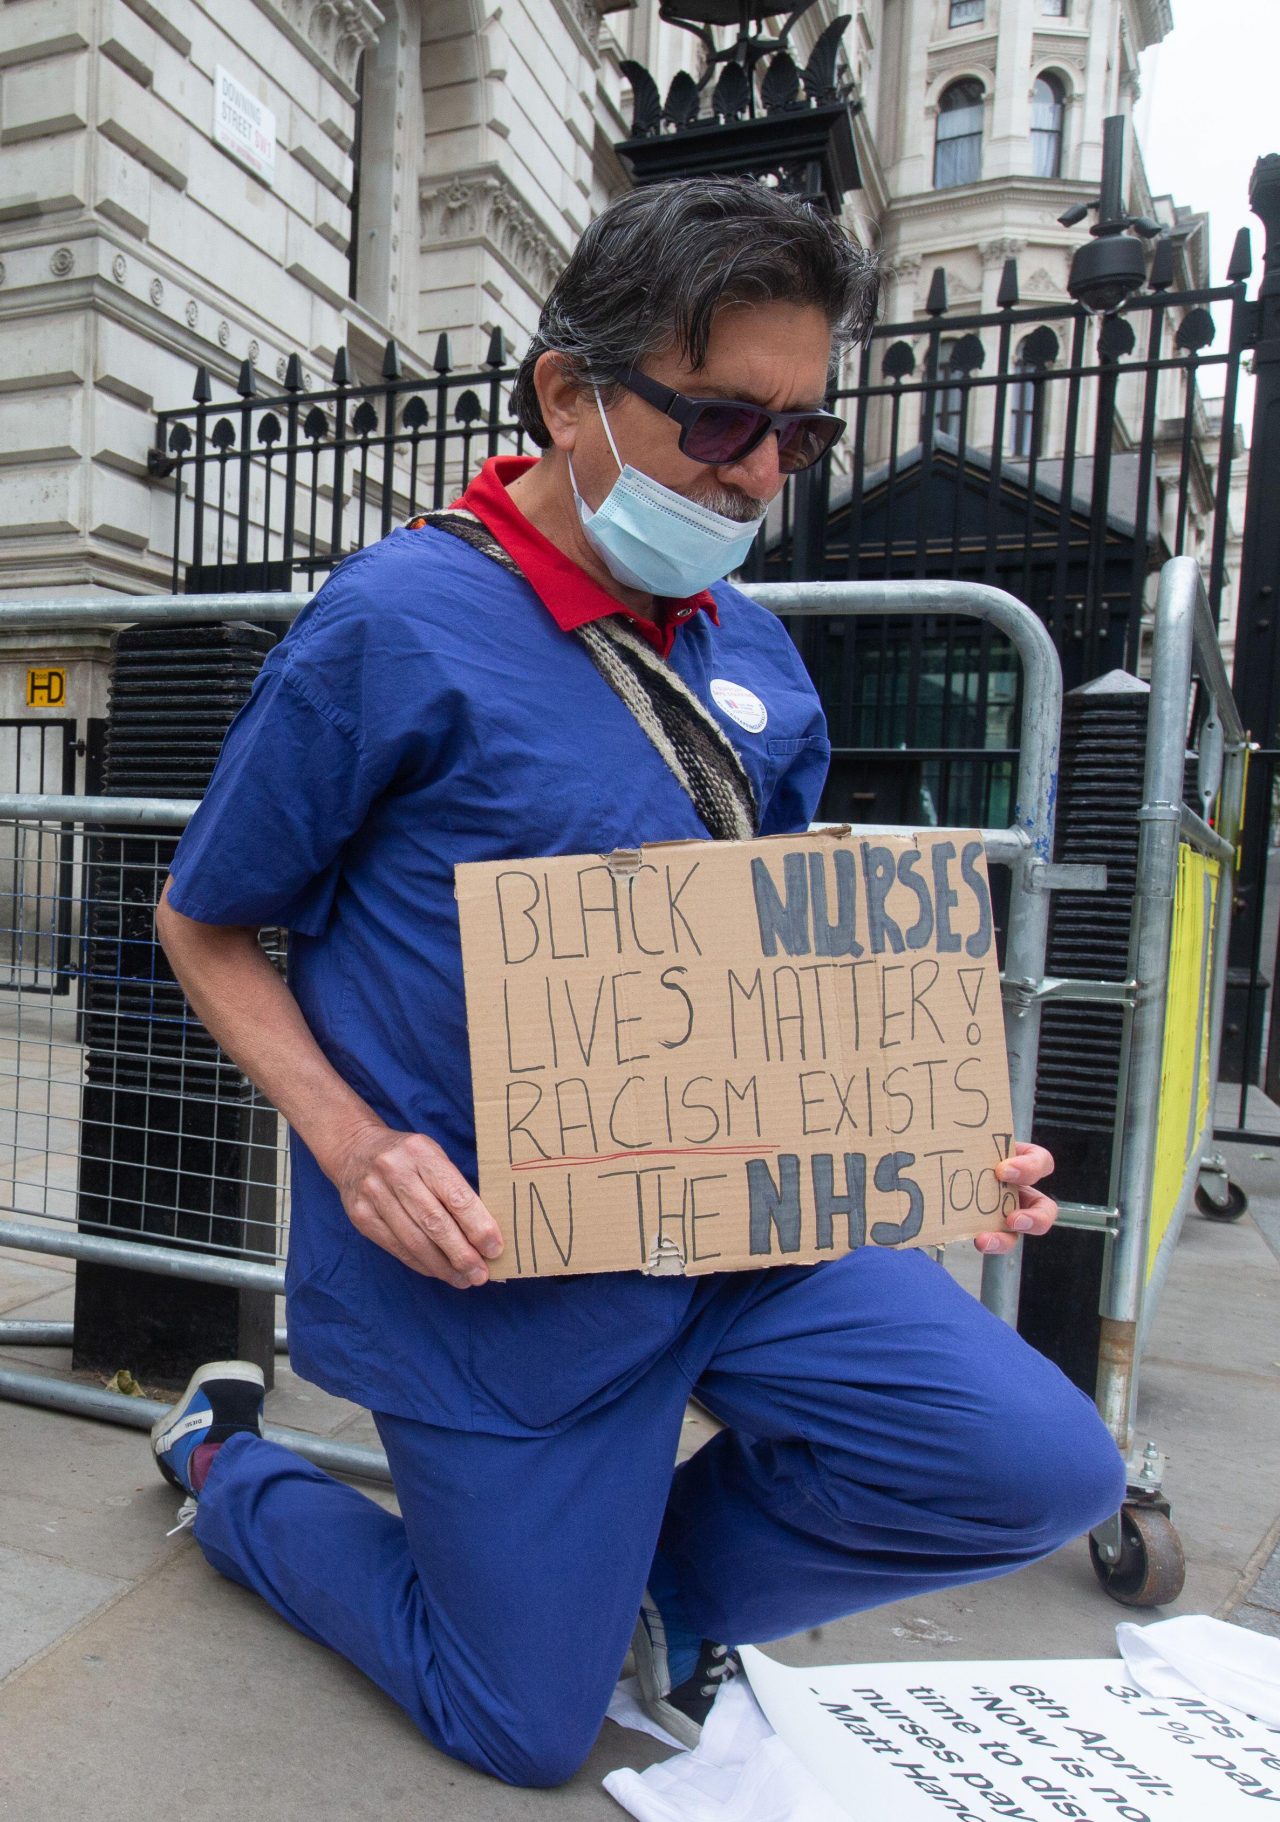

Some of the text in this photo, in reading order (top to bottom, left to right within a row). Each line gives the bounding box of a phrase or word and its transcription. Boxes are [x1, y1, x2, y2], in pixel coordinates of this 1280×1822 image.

[222, 101, 252, 140] STREET
[30, 672, 64, 703] HD
[495, 841, 993, 965] BLACK NURSES
[504, 959, 985, 1073] LIVES MATTER!
[507, 1057, 990, 1165] RACISM EXISTS
[513, 1174, 574, 1274] IN
[598, 1166, 727, 1264] THE
[746, 1152, 925, 1256] NHS
[818, 1701, 904, 1755] Matt
[851, 1688, 1038, 1822] nurses pay
[906, 1686, 982, 1735] time
[978, 1740, 1023, 1766] to
[1009, 1684, 1175, 1796] 6th April:
[1050, 1756, 1095, 1779] is
[1191, 1754, 1280, 1802] pay
